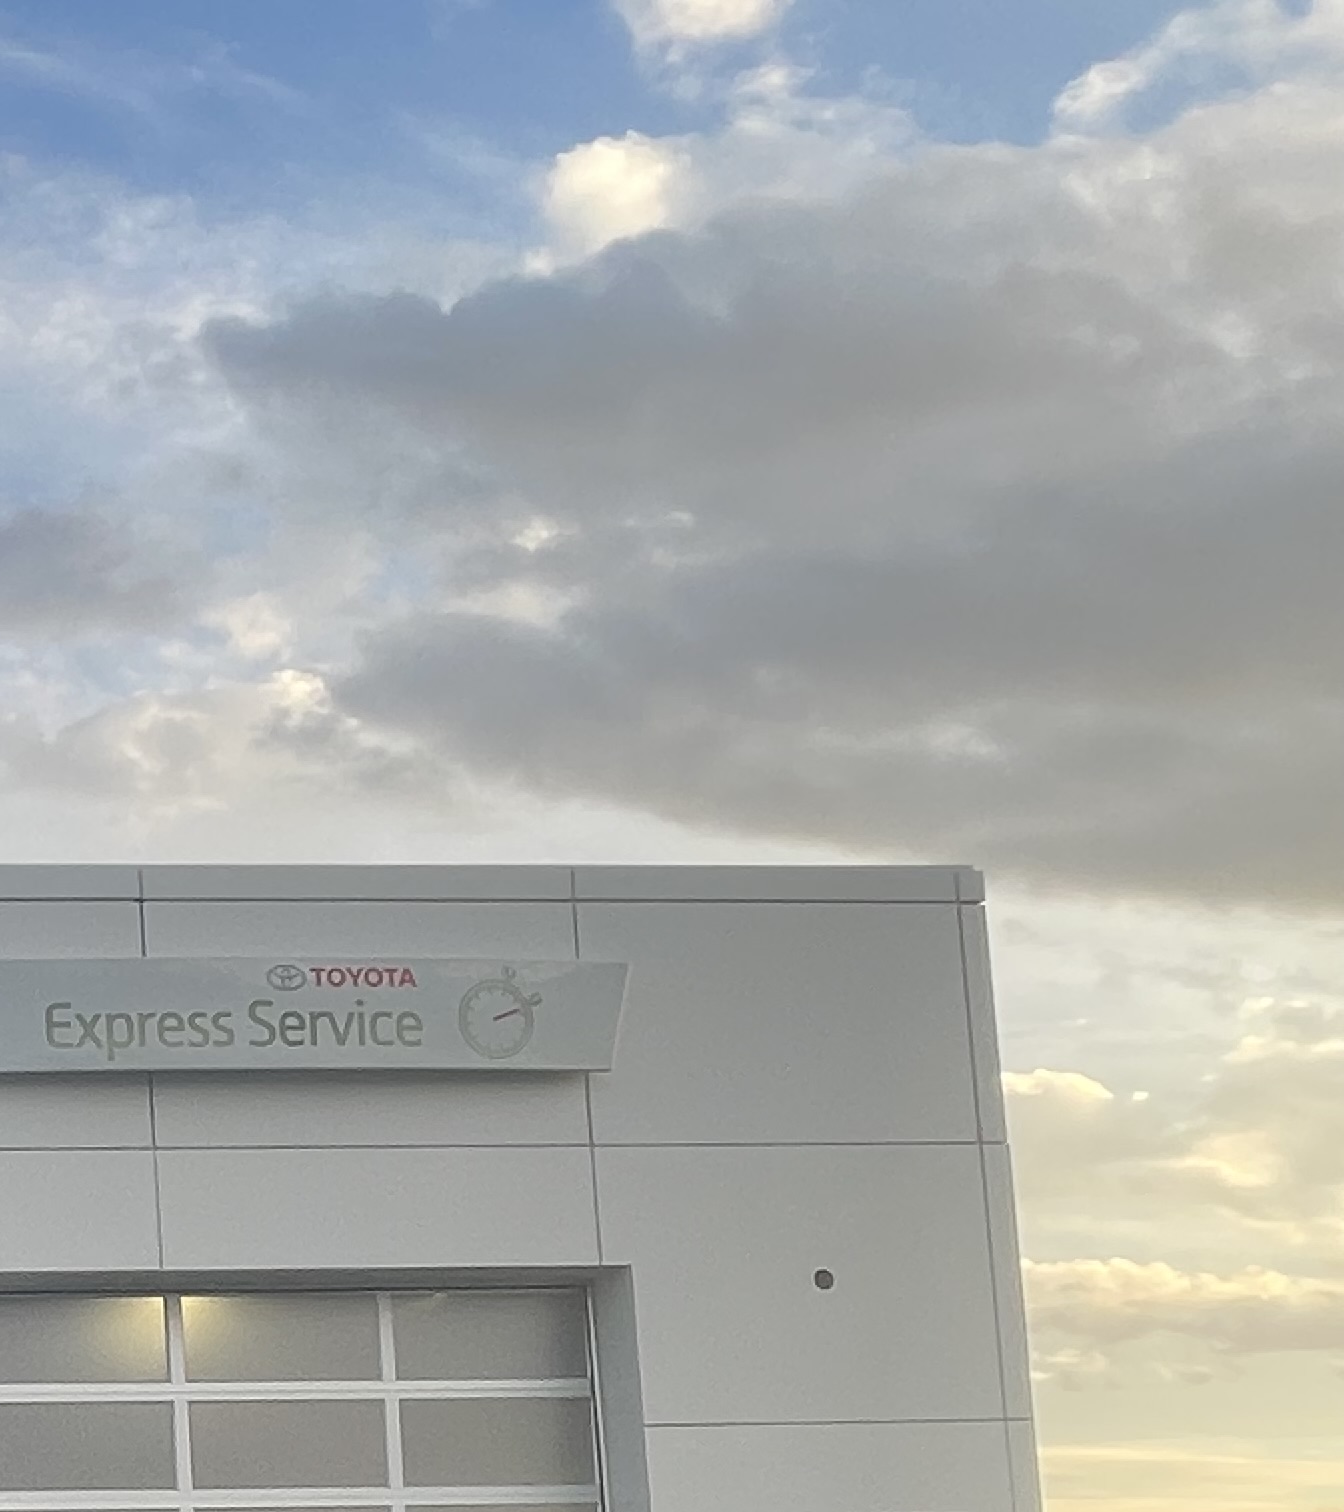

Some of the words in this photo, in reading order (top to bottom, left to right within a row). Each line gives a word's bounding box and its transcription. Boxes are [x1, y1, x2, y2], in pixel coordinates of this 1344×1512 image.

[309, 966, 417, 988] TOYOTA
[44, 1001, 235, 1059] Express
[248, 1000, 424, 1048] Service
